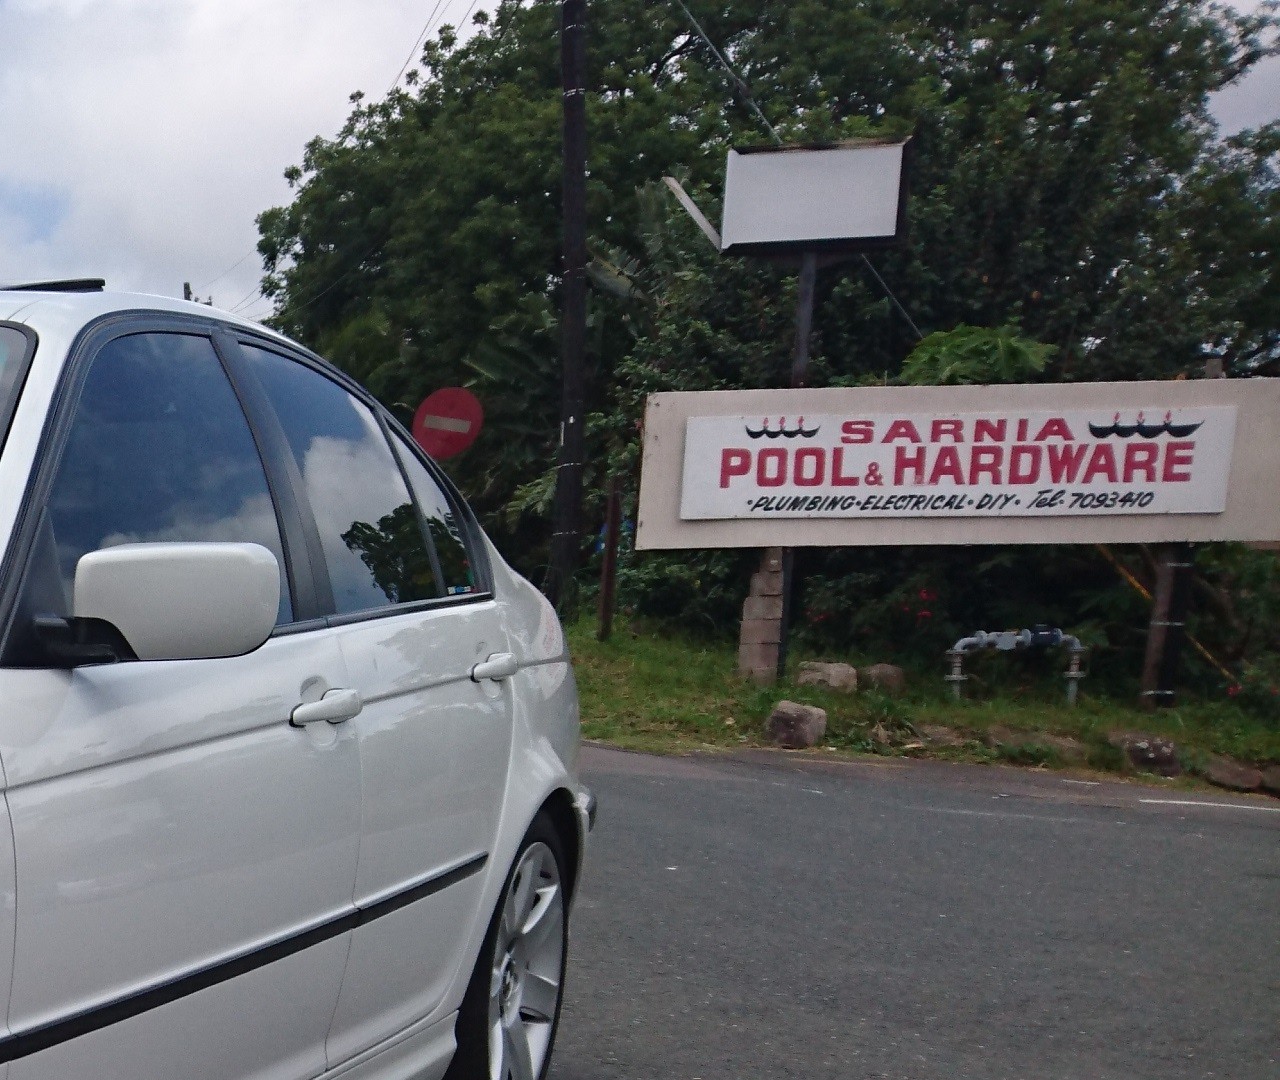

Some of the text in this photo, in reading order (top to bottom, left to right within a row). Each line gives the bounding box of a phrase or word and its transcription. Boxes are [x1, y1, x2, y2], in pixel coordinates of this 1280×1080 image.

[841, 417, 1075, 444] SARNIA
[719, 441, 1196, 489] POOL & HARDWARE
[751, 495, 855, 512] PLUMBING
